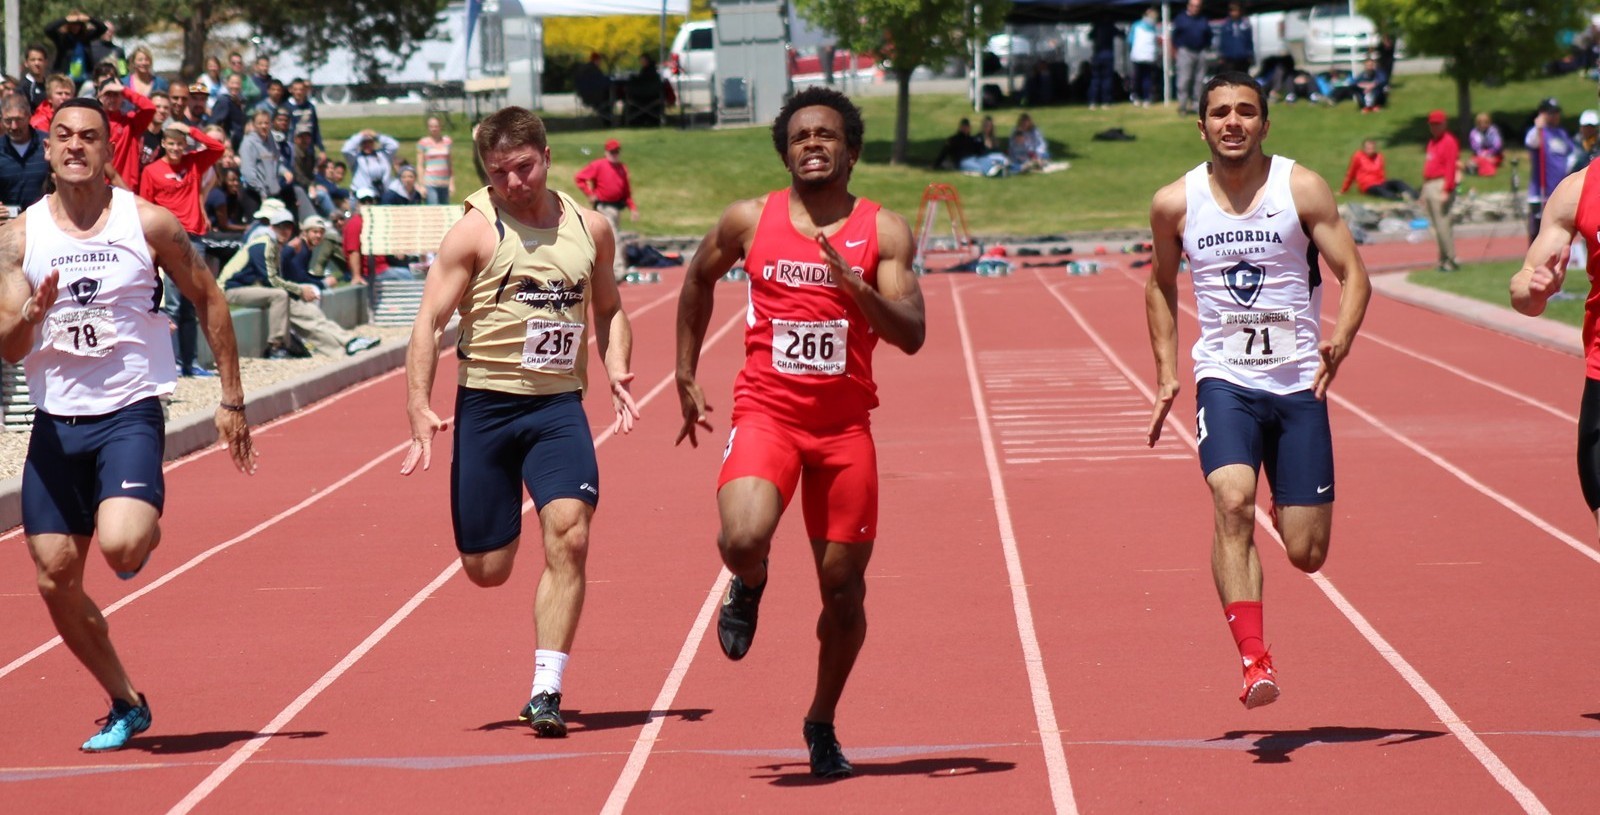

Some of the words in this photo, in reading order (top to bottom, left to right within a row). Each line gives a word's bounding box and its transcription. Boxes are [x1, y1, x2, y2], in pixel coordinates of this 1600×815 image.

[1197, 230, 1283, 250] CONCORDIA
[51, 253, 120, 267] CONCORDIA
[1215, 246, 1266, 257] CAVALIERS
[776, 259, 865, 287] RAIDS
[1235, 269, 1253, 289] C
[78, 282, 92, 297] C
[515, 291, 563, 301] OREGON
[1238, 313, 1260, 325] CASCADE
[1260, 311, 1290, 324] CONFERENCE
[67, 323, 98, 350] 78
[535, 329, 574, 356] 236
[785, 330, 834, 360] 266
[1243, 327, 1273, 355] 71
[777, 360, 841, 371] CHAMPIONSHIPS
[1228, 356, 1291, 367] CHAMPIONSHIPS
